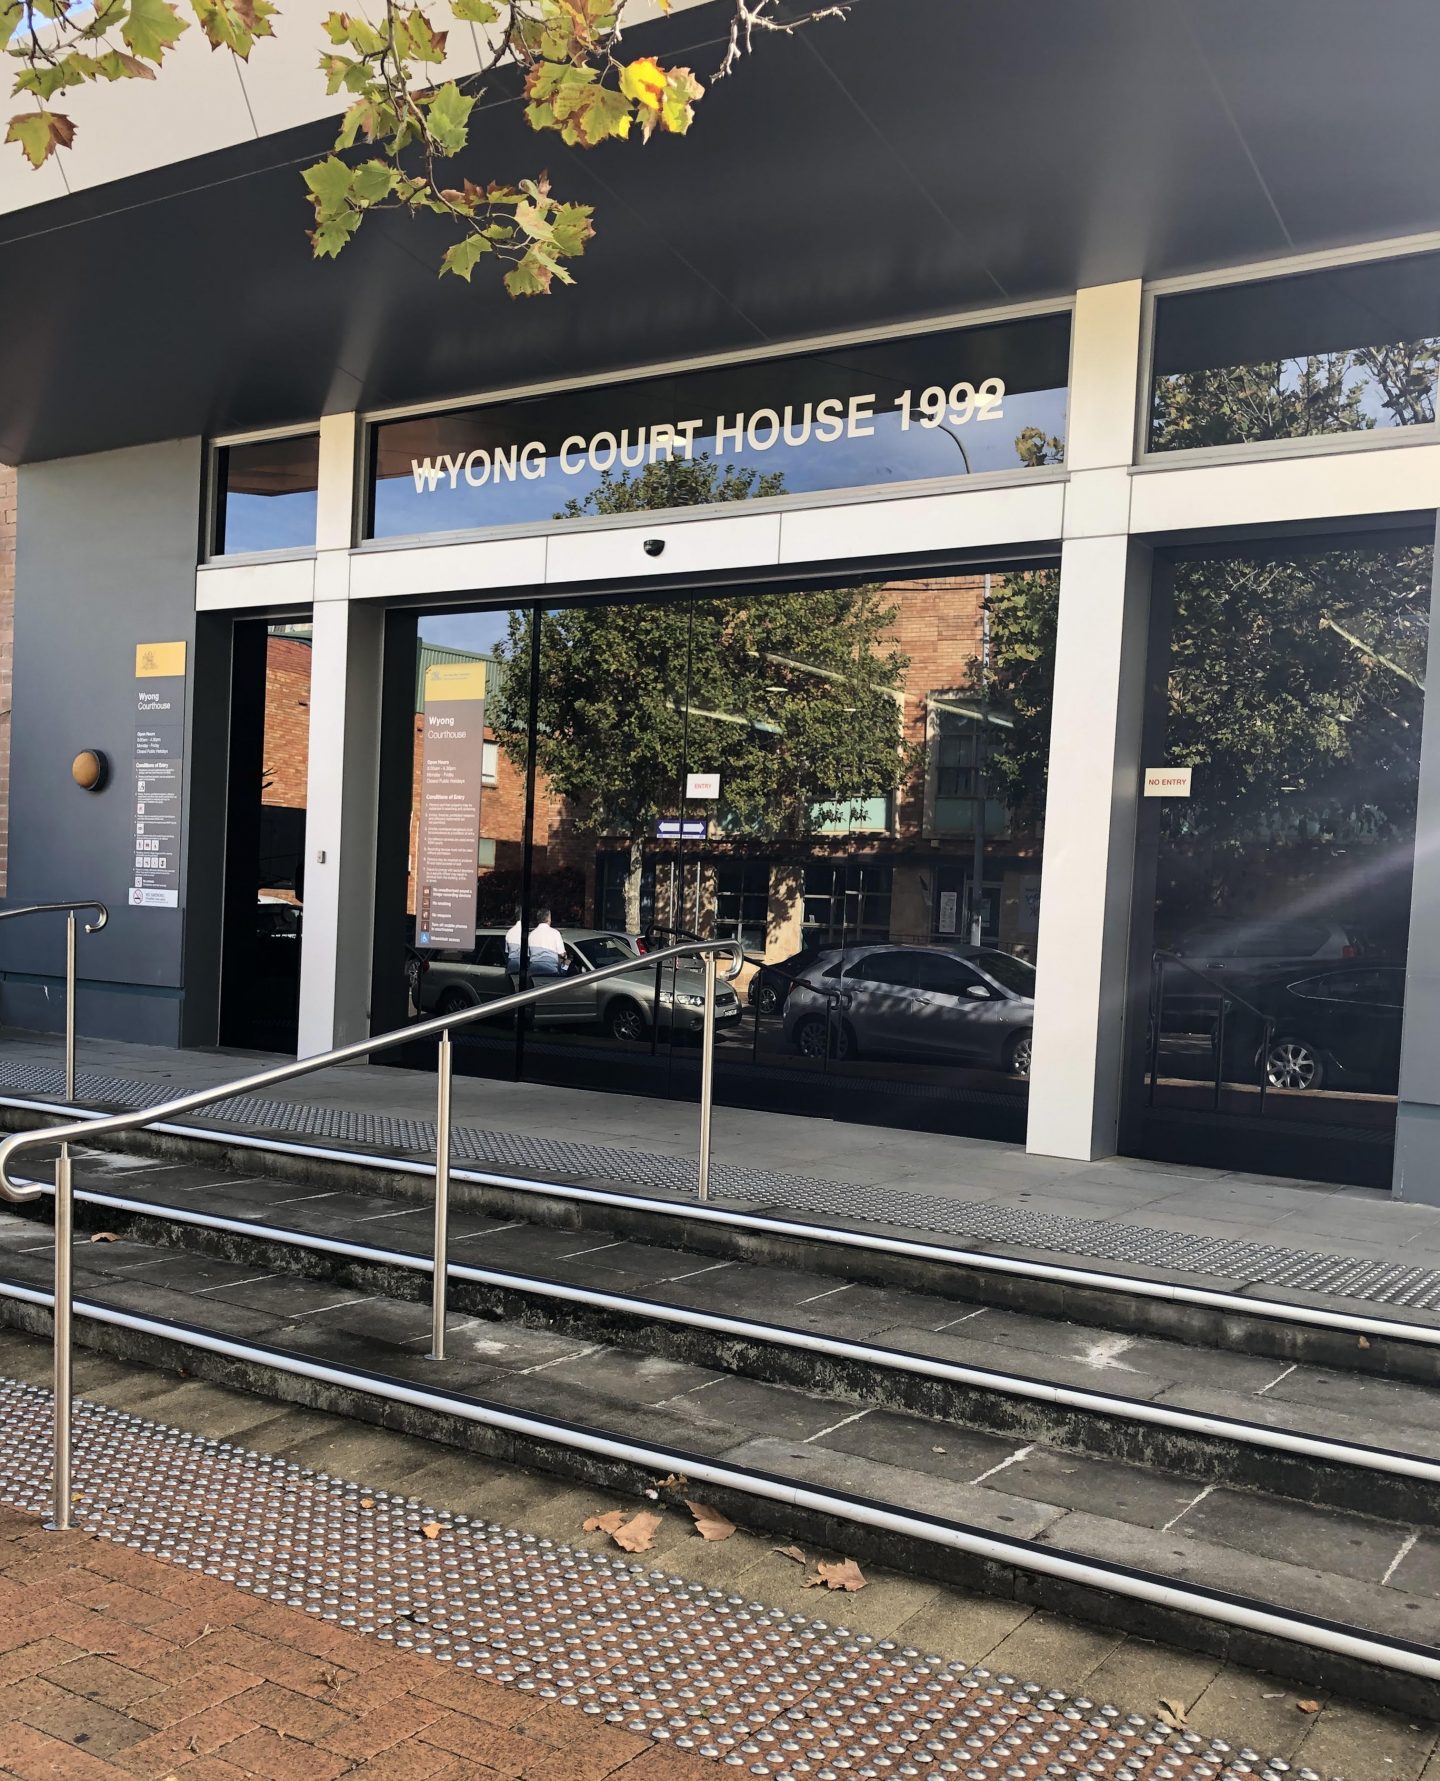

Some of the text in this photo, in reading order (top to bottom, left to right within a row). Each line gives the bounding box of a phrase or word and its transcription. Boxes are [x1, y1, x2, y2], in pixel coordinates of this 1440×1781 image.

[411, 377, 1007, 493] WYONG COURT HOUSE 1992
[138, 692, 160, 702] Wyong
[137, 702, 171, 710] Courthouse
[428, 716, 455, 728] Wyong
[427, 730, 467, 739] Courthouse
